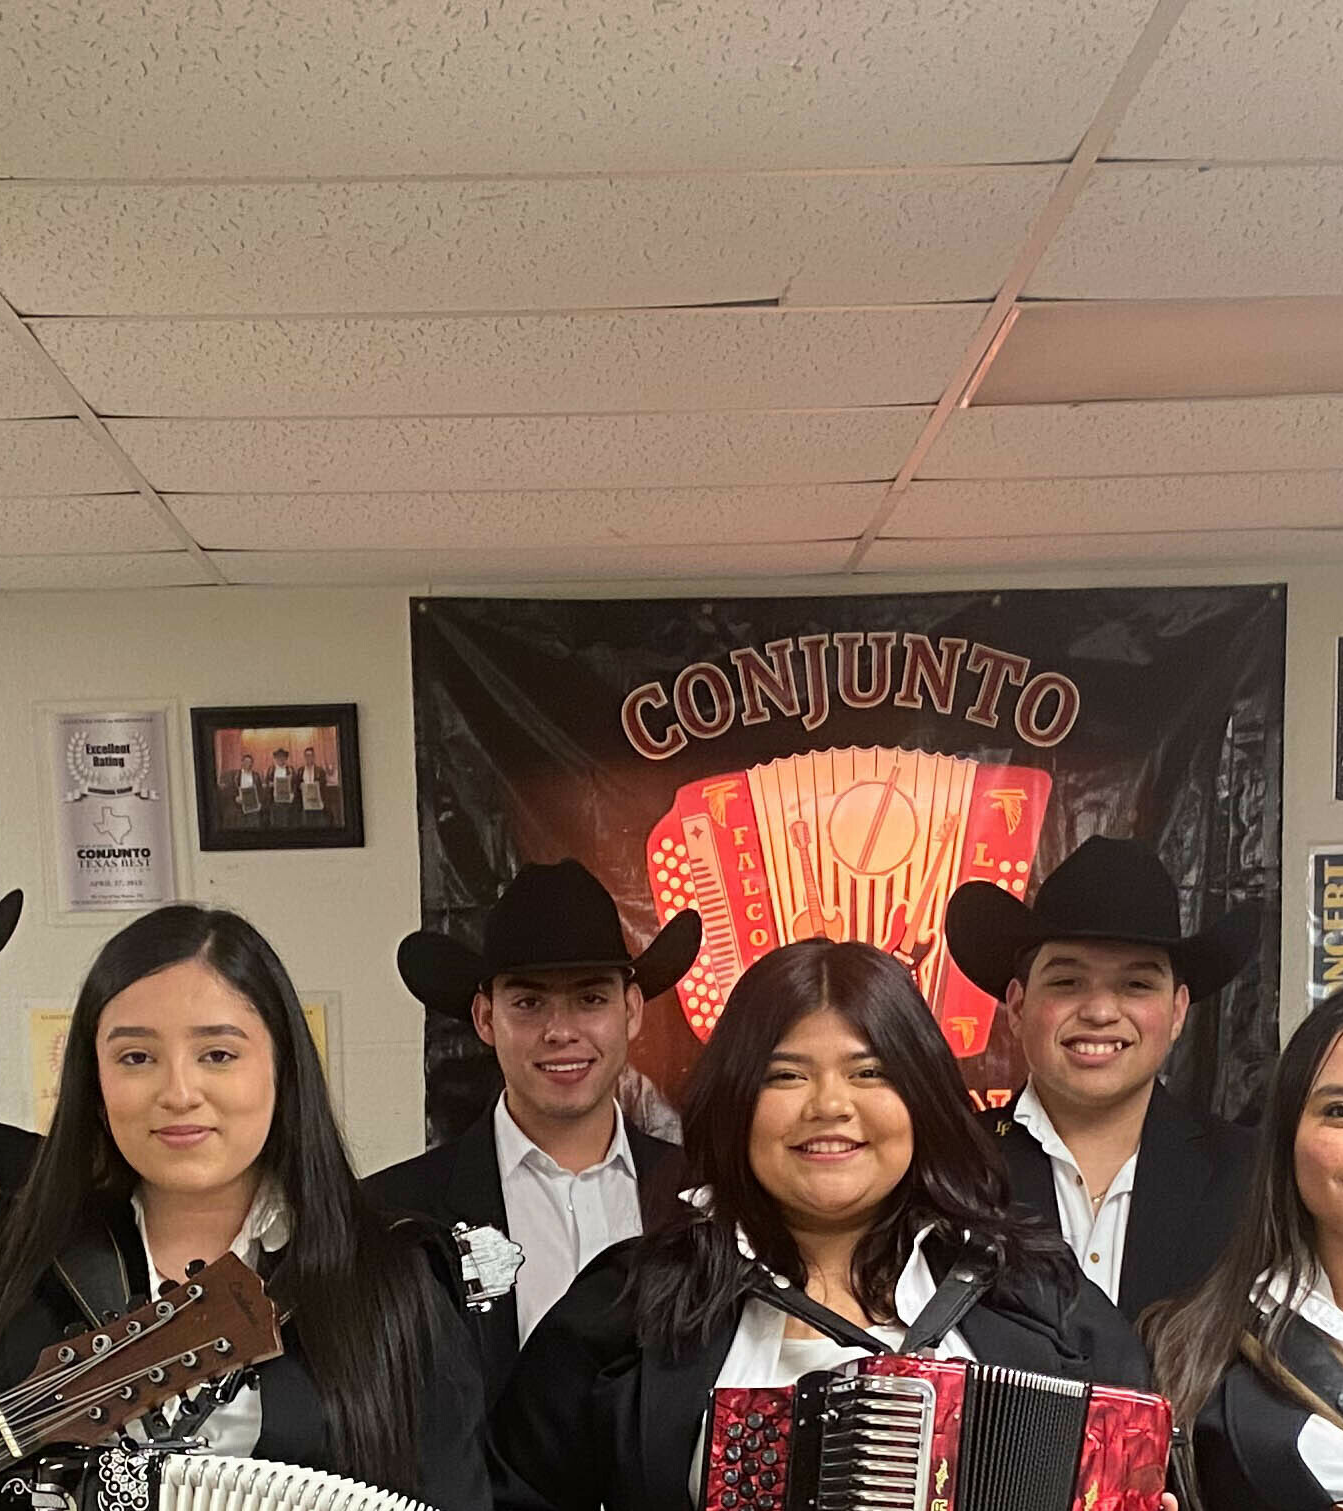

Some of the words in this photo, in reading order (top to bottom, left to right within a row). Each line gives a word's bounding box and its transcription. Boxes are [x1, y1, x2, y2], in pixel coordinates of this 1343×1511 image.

[621, 632, 1080, 760] CONJUNTO
[86, 744, 130, 755] Excellent
[93, 756, 124, 767] Rating
[77, 848, 151, 859] CONJUNTO
[80, 860, 117, 868] TEXAS
[121, 859, 150, 867] BEST
[732, 826, 769, 957] FALCO
